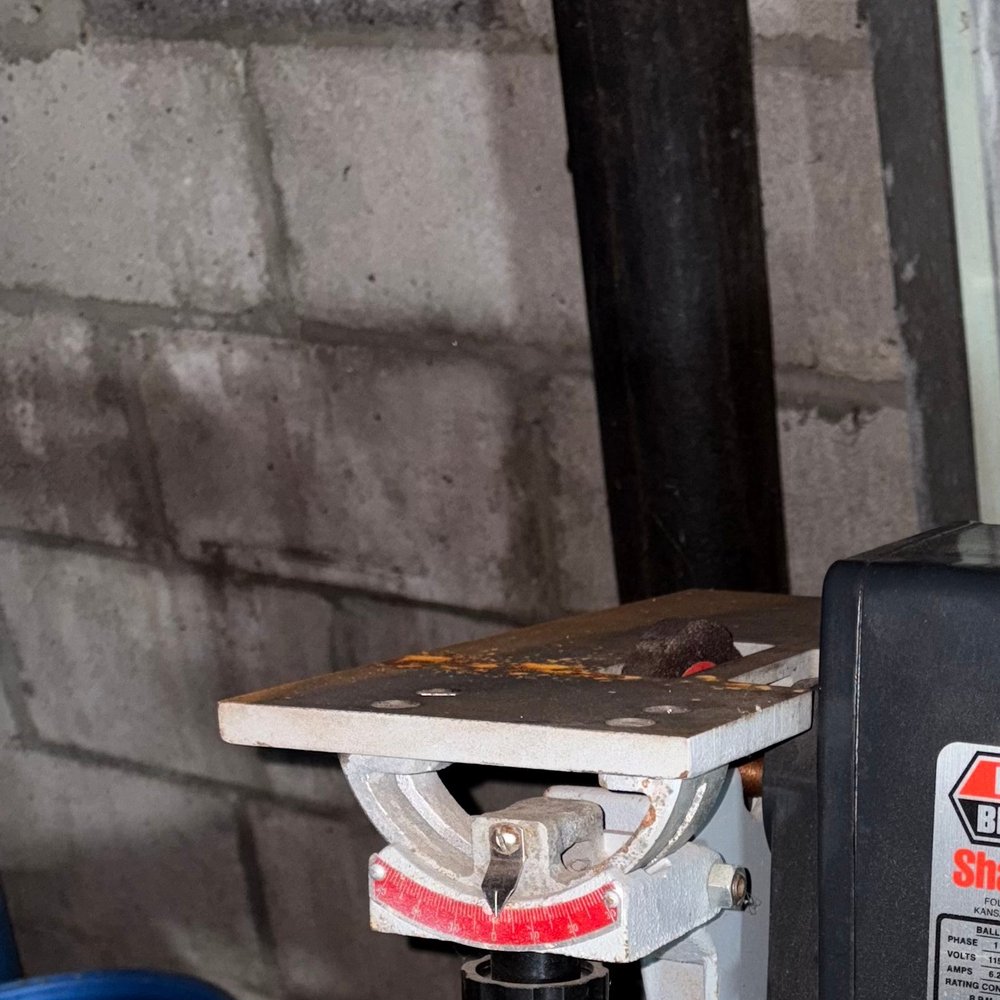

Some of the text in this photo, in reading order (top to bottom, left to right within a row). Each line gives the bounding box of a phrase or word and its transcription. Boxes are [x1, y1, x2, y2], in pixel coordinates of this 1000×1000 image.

[976, 926, 1000, 937] BALL
[947, 935, 998, 950] PHASE 1
[947, 950, 976, 961] VOLTS
[947, 965, 973, 975] AMPS
[945, 978, 979, 990] RATING
